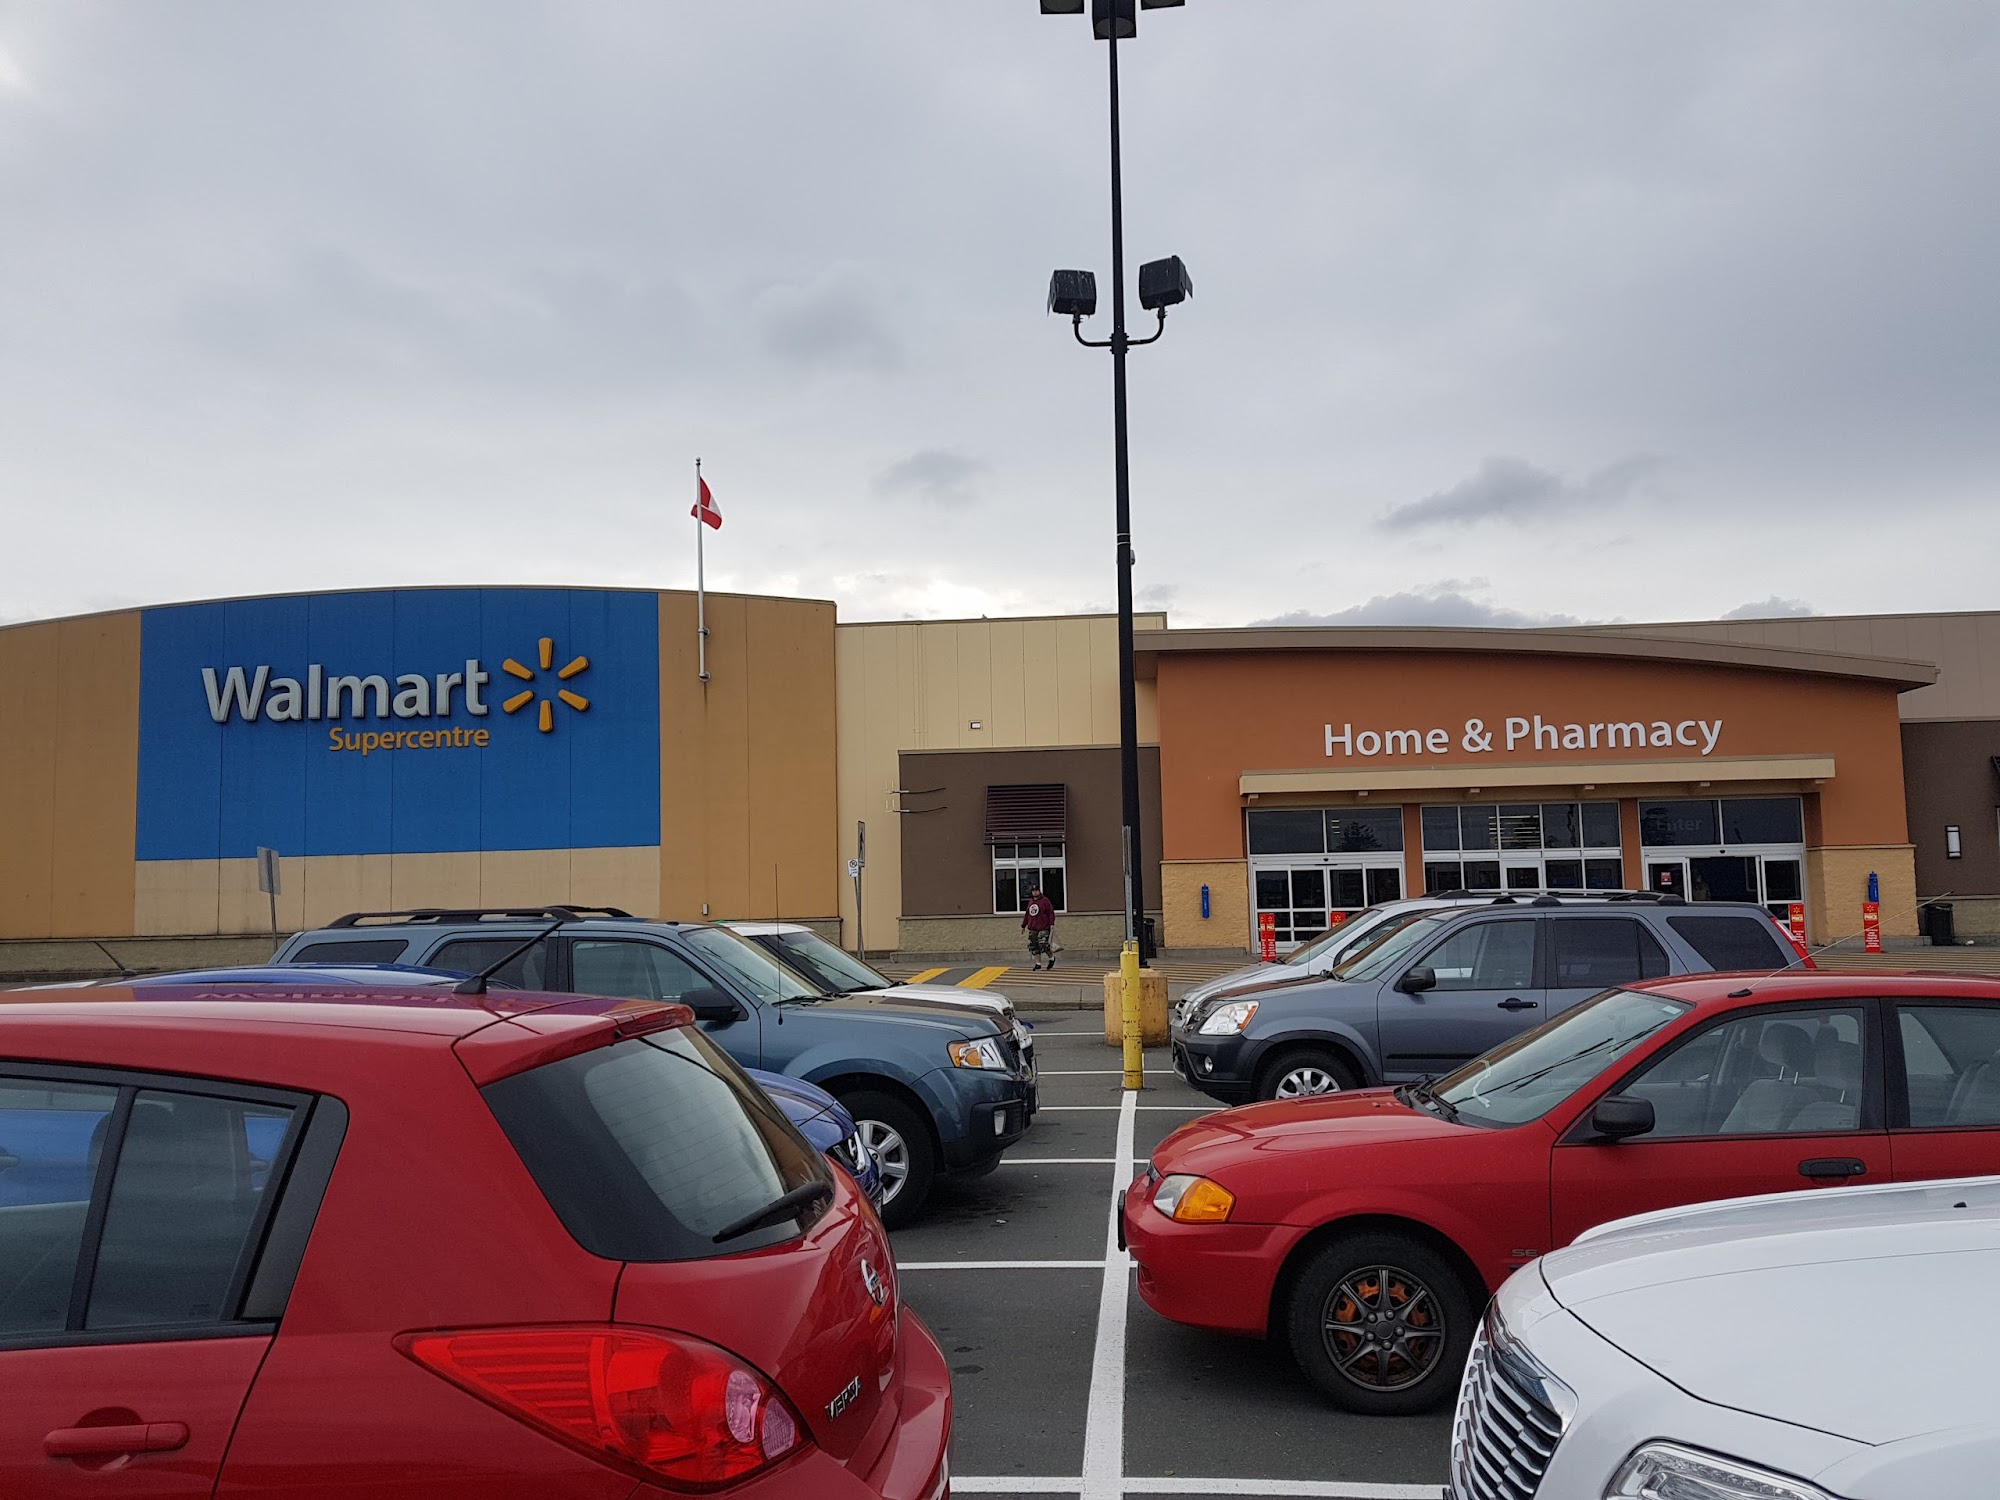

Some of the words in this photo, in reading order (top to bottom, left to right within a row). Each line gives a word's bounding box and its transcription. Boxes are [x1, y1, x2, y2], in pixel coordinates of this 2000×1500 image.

[201, 659, 490, 723] Walmart
[329, 726, 490, 756] Supercentre
[1324, 723, 1449, 757] Home
[1461, 718, 1493, 753] &
[1506, 714, 1723, 756] Pharmacy
[1655, 818, 1703, 832] Enter
[1511, 1248, 1538, 1257] SE
